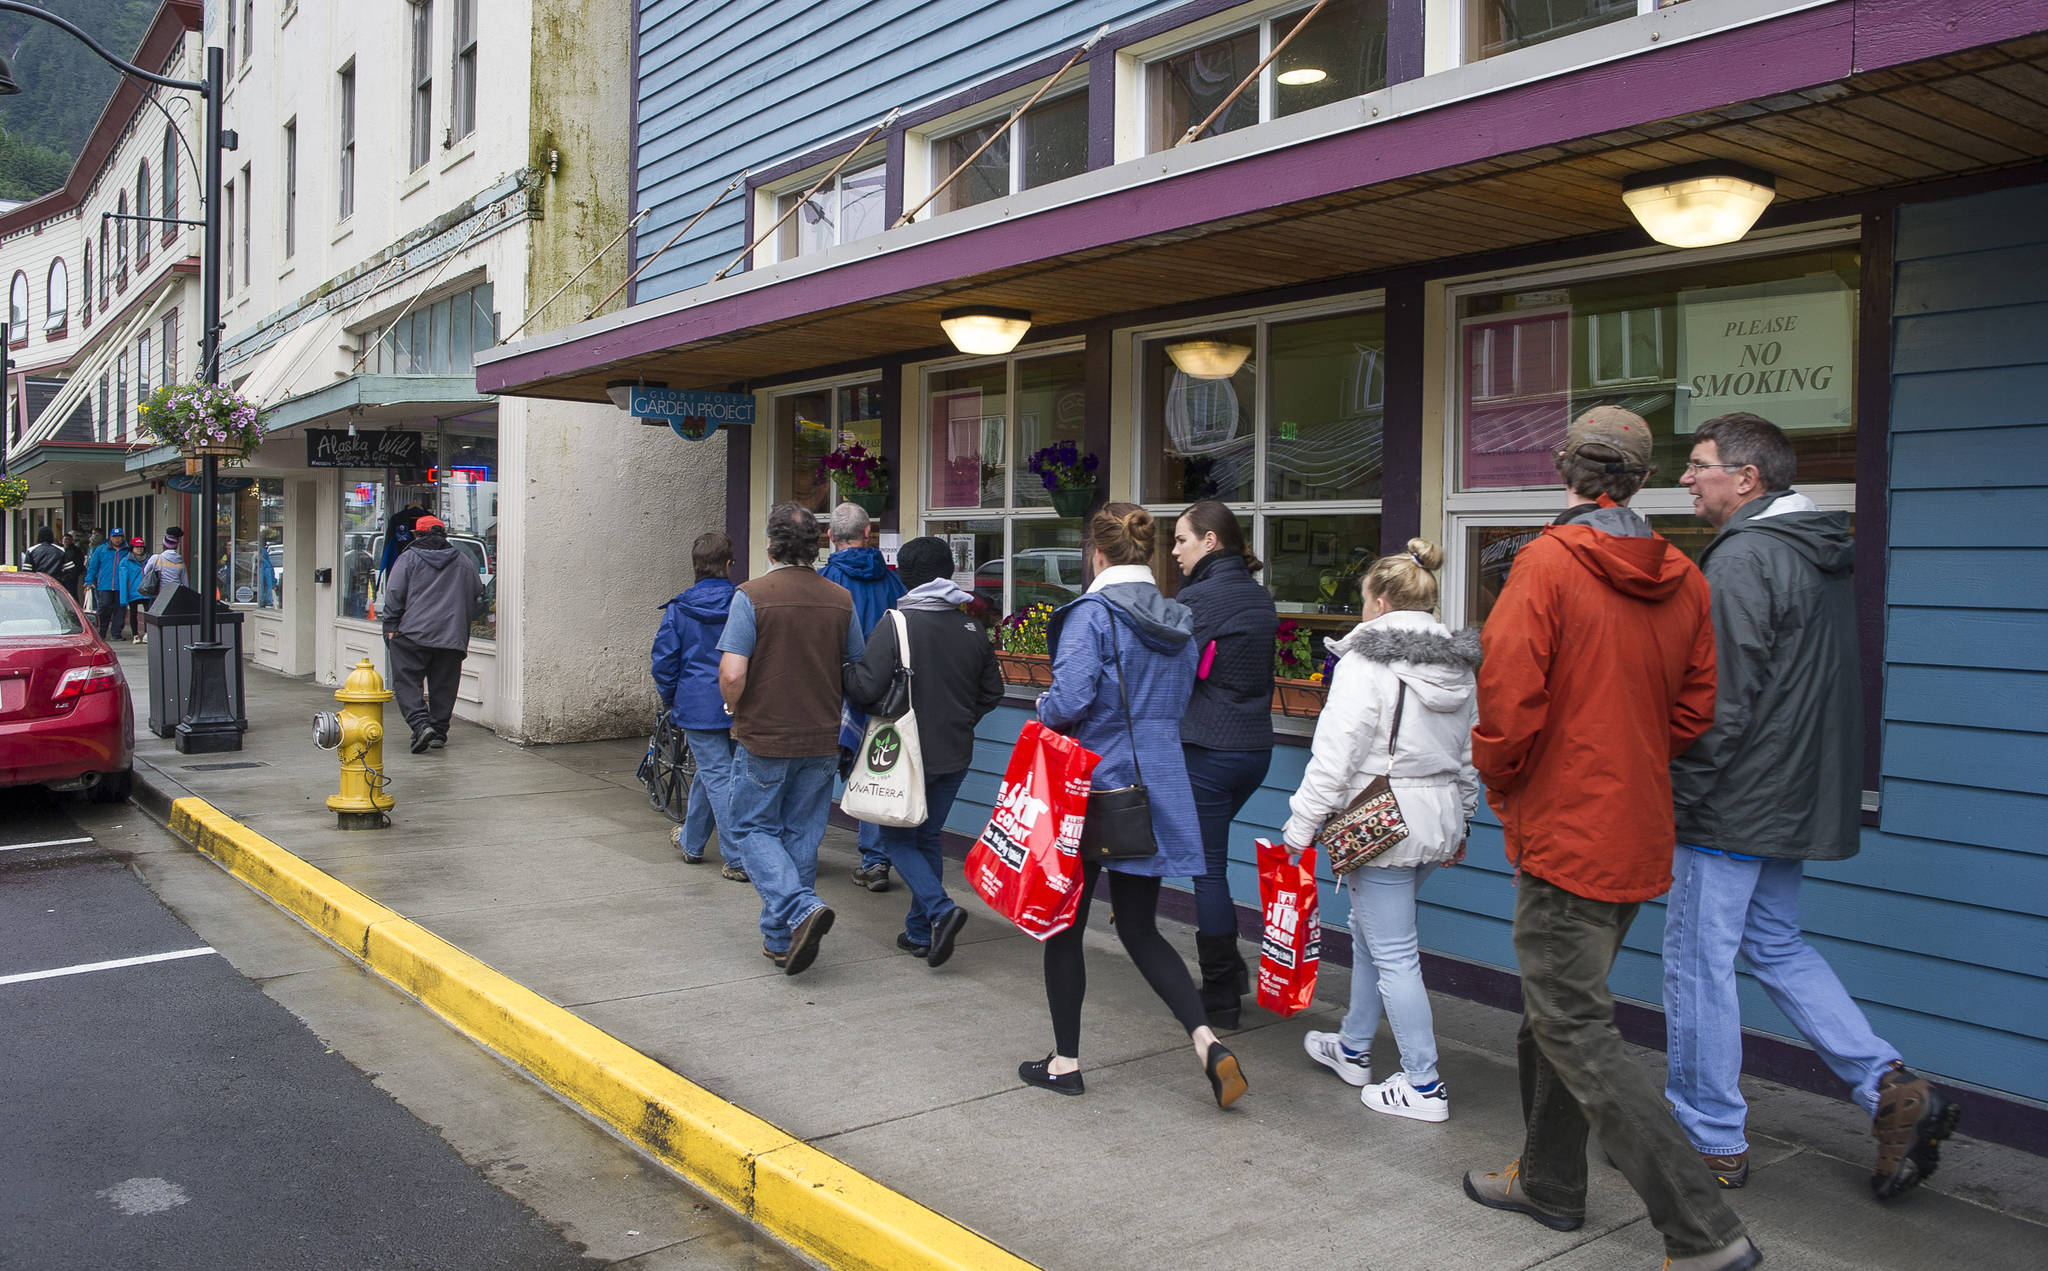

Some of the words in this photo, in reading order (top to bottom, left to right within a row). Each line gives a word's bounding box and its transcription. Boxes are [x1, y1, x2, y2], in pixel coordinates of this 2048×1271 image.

[1724, 315, 1798, 337] PLEASE
[1738, 341, 1782, 368] NO
[1691, 365, 1834, 399] SMOKING
[634, 397, 694, 417] GARDEN
[697, 403, 754, 421] PROJECT
[317, 434, 368, 458] Alaska
[378, 432, 416, 458] Wild
